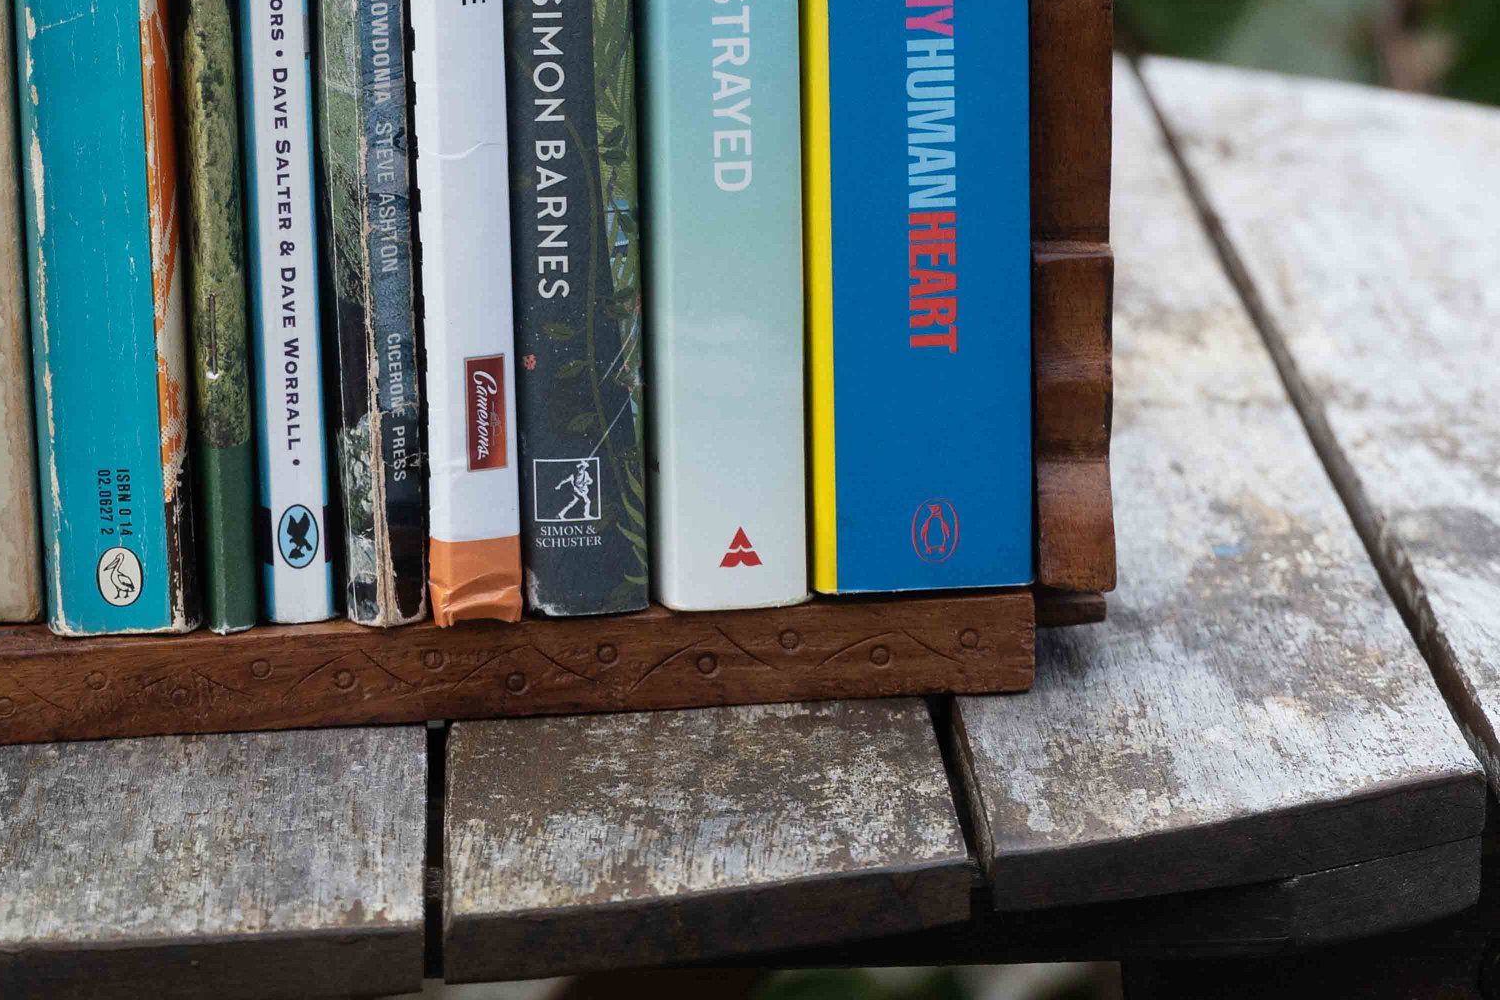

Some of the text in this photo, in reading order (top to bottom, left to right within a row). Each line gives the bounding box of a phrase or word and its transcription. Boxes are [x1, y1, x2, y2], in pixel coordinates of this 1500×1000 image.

[374, 122, 398, 273] STEVE ASHTON
[535, 139, 570, 299] BARNES
[272, 67, 302, 451] DAVE SALTER & DAVE WORRALL
[386, 332, 407, 482] CICERONE PRESS
[473, 370, 498, 460] Camerons
[97, 469, 114, 535] 02.0627 2
[116, 469, 132, 536] ISBN 0 14
[535, 536, 602, 548] SCHUSTER
[540, 525, 596, 537] SIMON &
